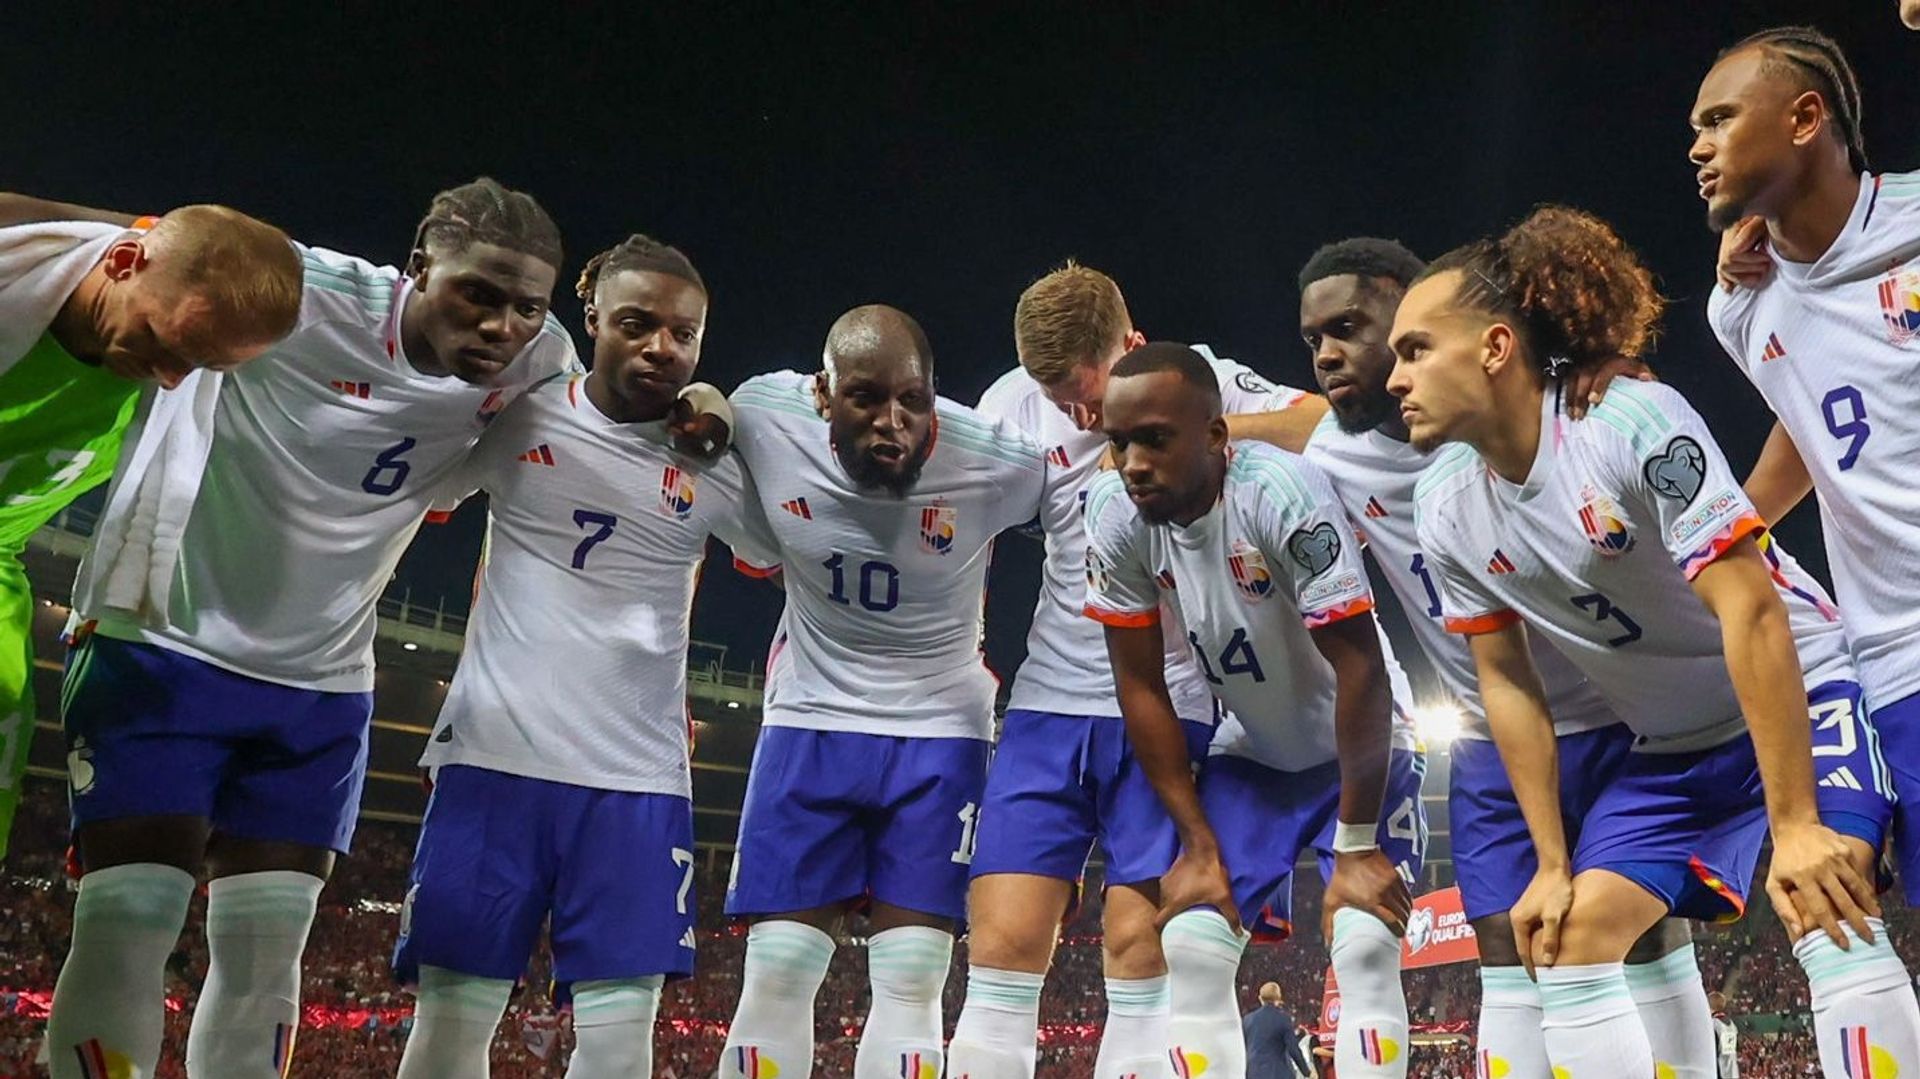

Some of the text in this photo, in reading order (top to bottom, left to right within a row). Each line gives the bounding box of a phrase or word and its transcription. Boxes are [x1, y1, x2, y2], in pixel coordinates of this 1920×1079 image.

[1821, 385, 1871, 472] 9
[361, 436, 416, 496] 6
[571, 509, 617, 570] 7
[822, 551, 900, 612] 10
[1570, 592, 1642, 648] 3
[1189, 626, 1266, 686] 14
[1808, 698, 1857, 757] 3
[950, 802, 982, 865] 1
[671, 847, 695, 915] 7
